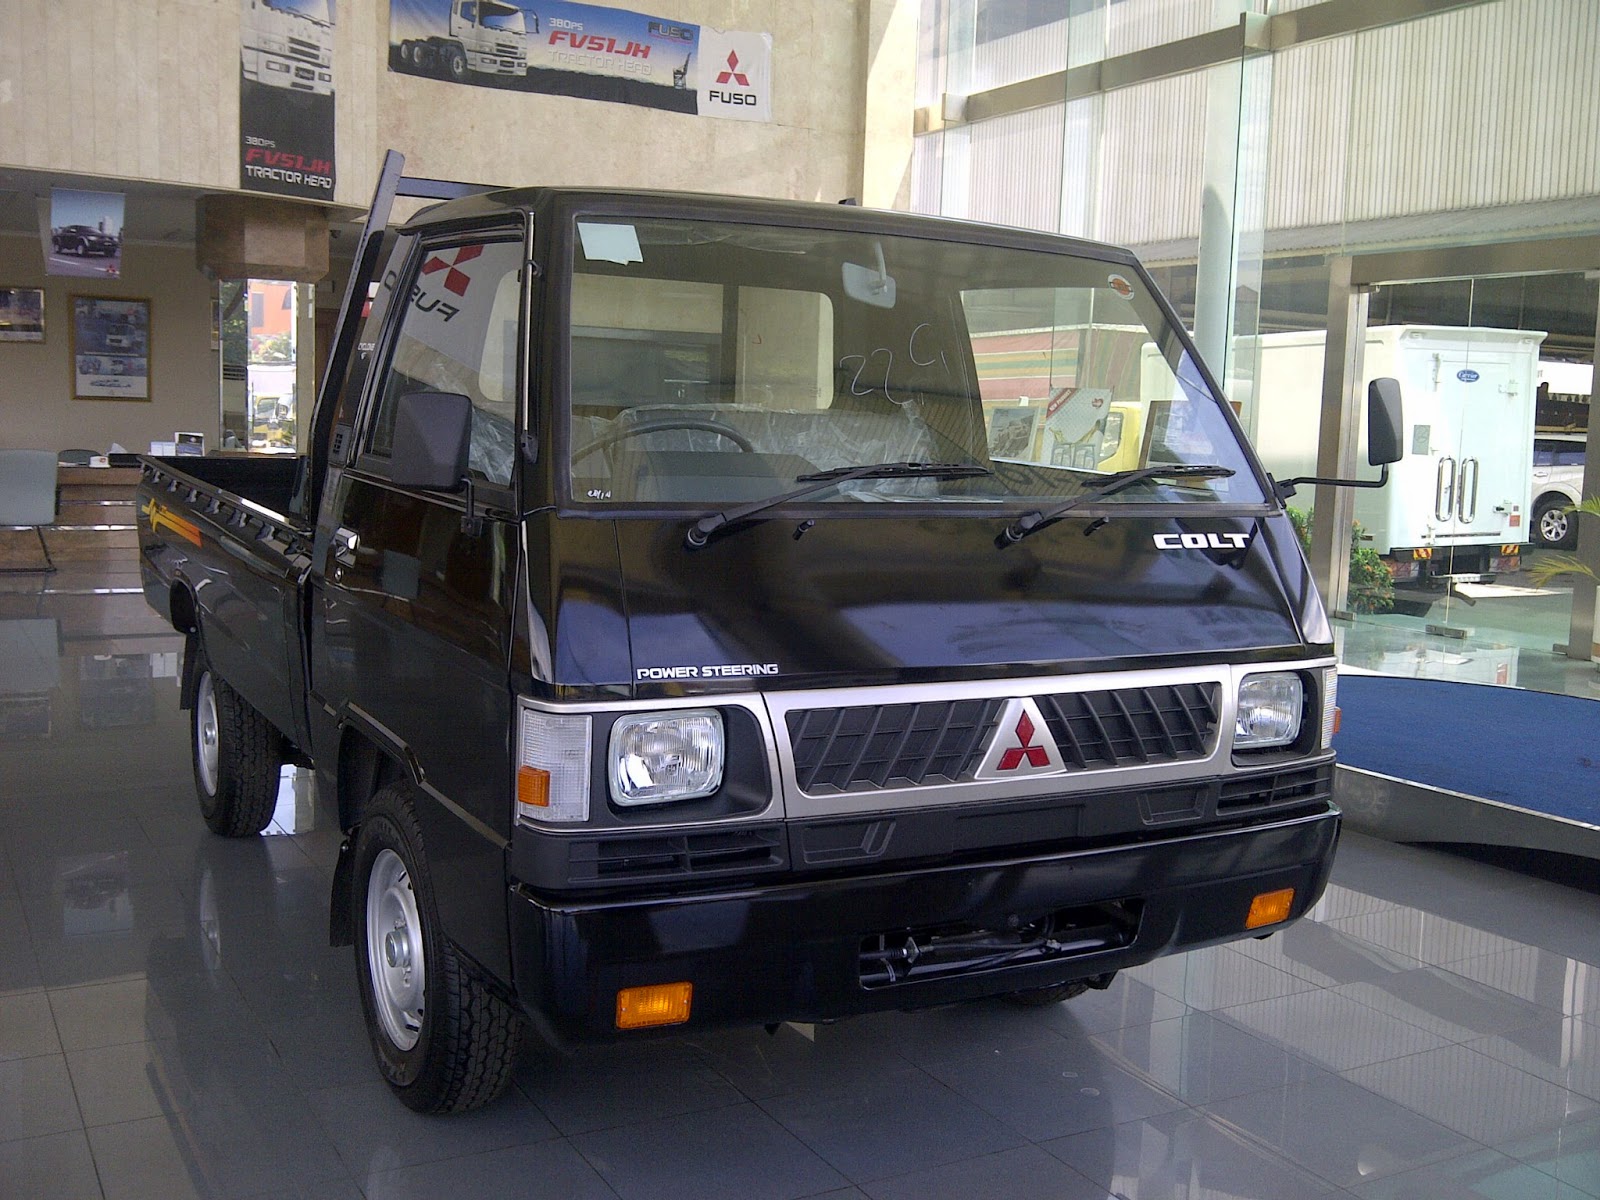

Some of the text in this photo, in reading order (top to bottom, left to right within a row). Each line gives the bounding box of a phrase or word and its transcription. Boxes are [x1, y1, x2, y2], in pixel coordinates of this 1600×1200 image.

[549, 17, 584, 31] 380PS
[648, 21, 694, 41] FUSO
[548, 30, 651, 59] FV51JH
[549, 50, 652, 76] TRACTOR HEAD
[709, 90, 757, 106] FUSO
[245, 135, 276, 148] 380PS
[245, 148, 331, 175] FV51JH
[245, 164, 333, 189] TRACTOR HEAD
[1152, 533, 1250, 550] COLT
[637, 664, 779, 680] POWER STEERING
